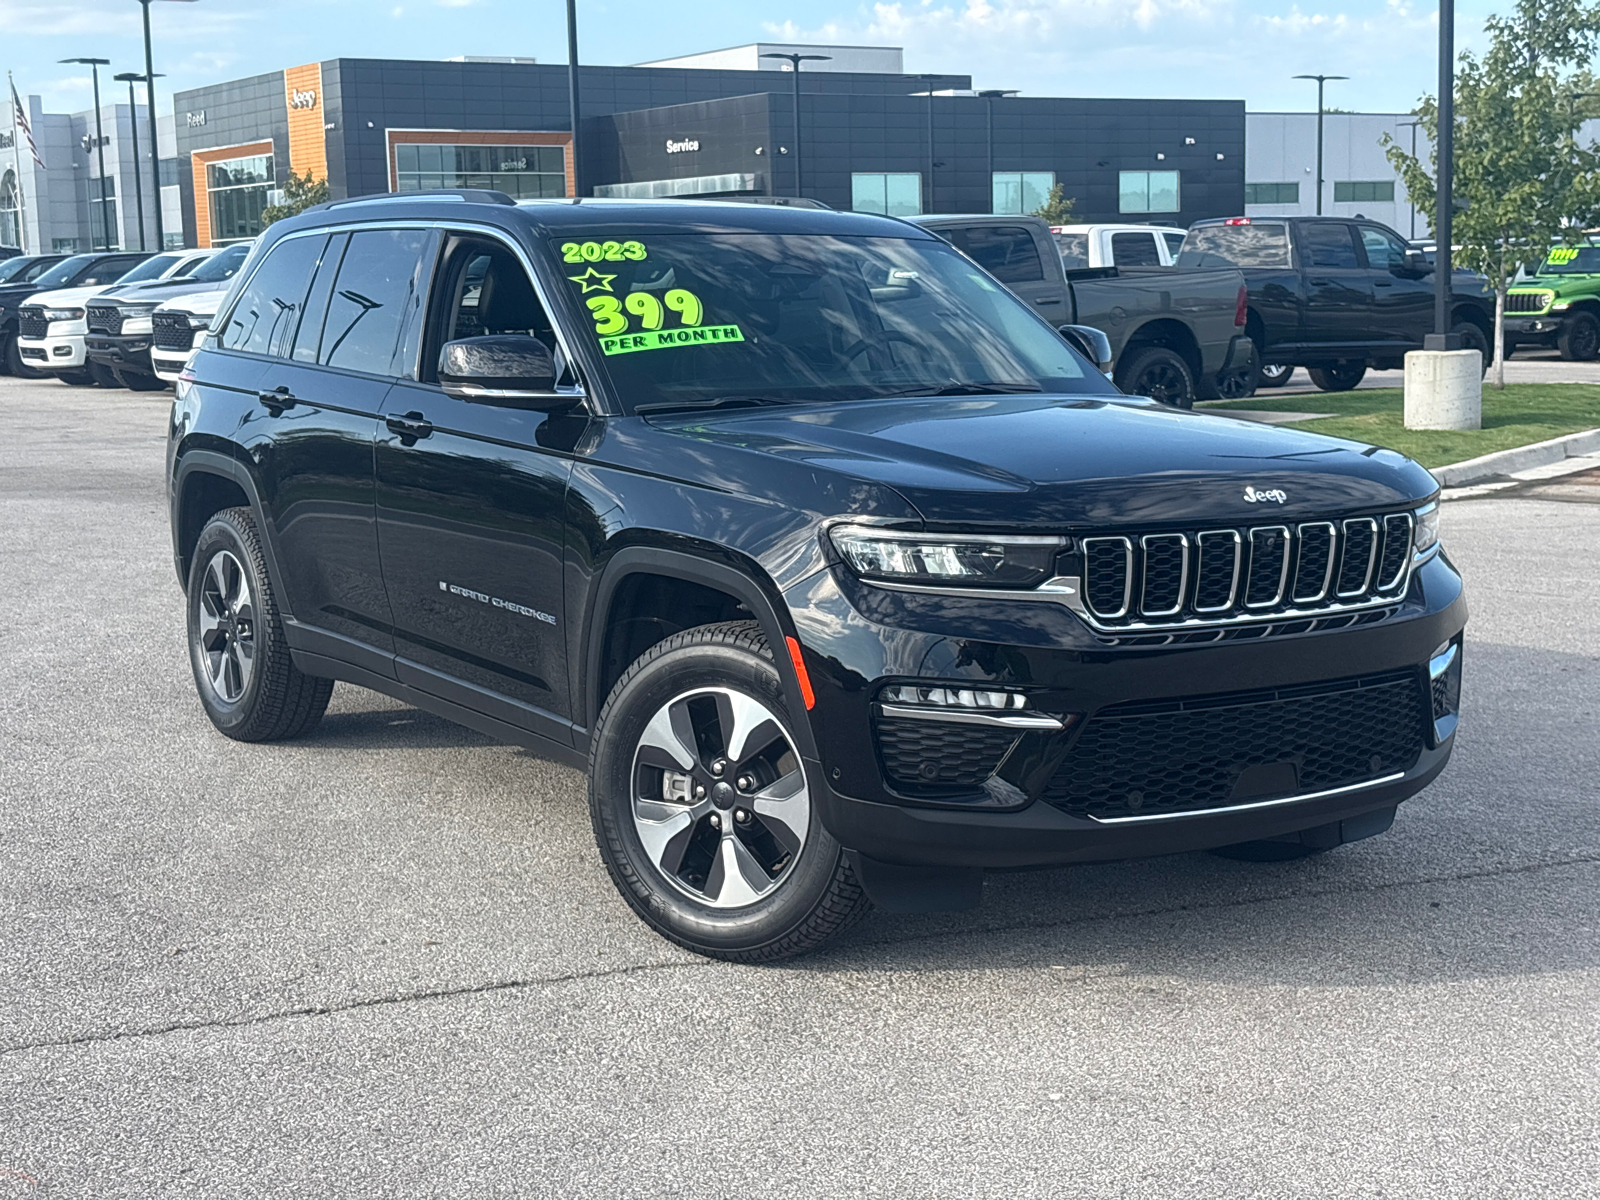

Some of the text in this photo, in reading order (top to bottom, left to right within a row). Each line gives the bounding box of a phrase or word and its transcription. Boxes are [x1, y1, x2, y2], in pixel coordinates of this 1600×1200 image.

[290, 88, 316, 110] Jeep
[187, 110, 206, 127] Reed
[666, 138, 700, 153] Service
[561, 240, 648, 264] 2023
[585, 288, 704, 335] 399
[603, 327, 739, 352] PER MONTH
[1243, 486, 1287, 504] Jeep
[449, 584, 558, 626] GRAND CHEROKEE
